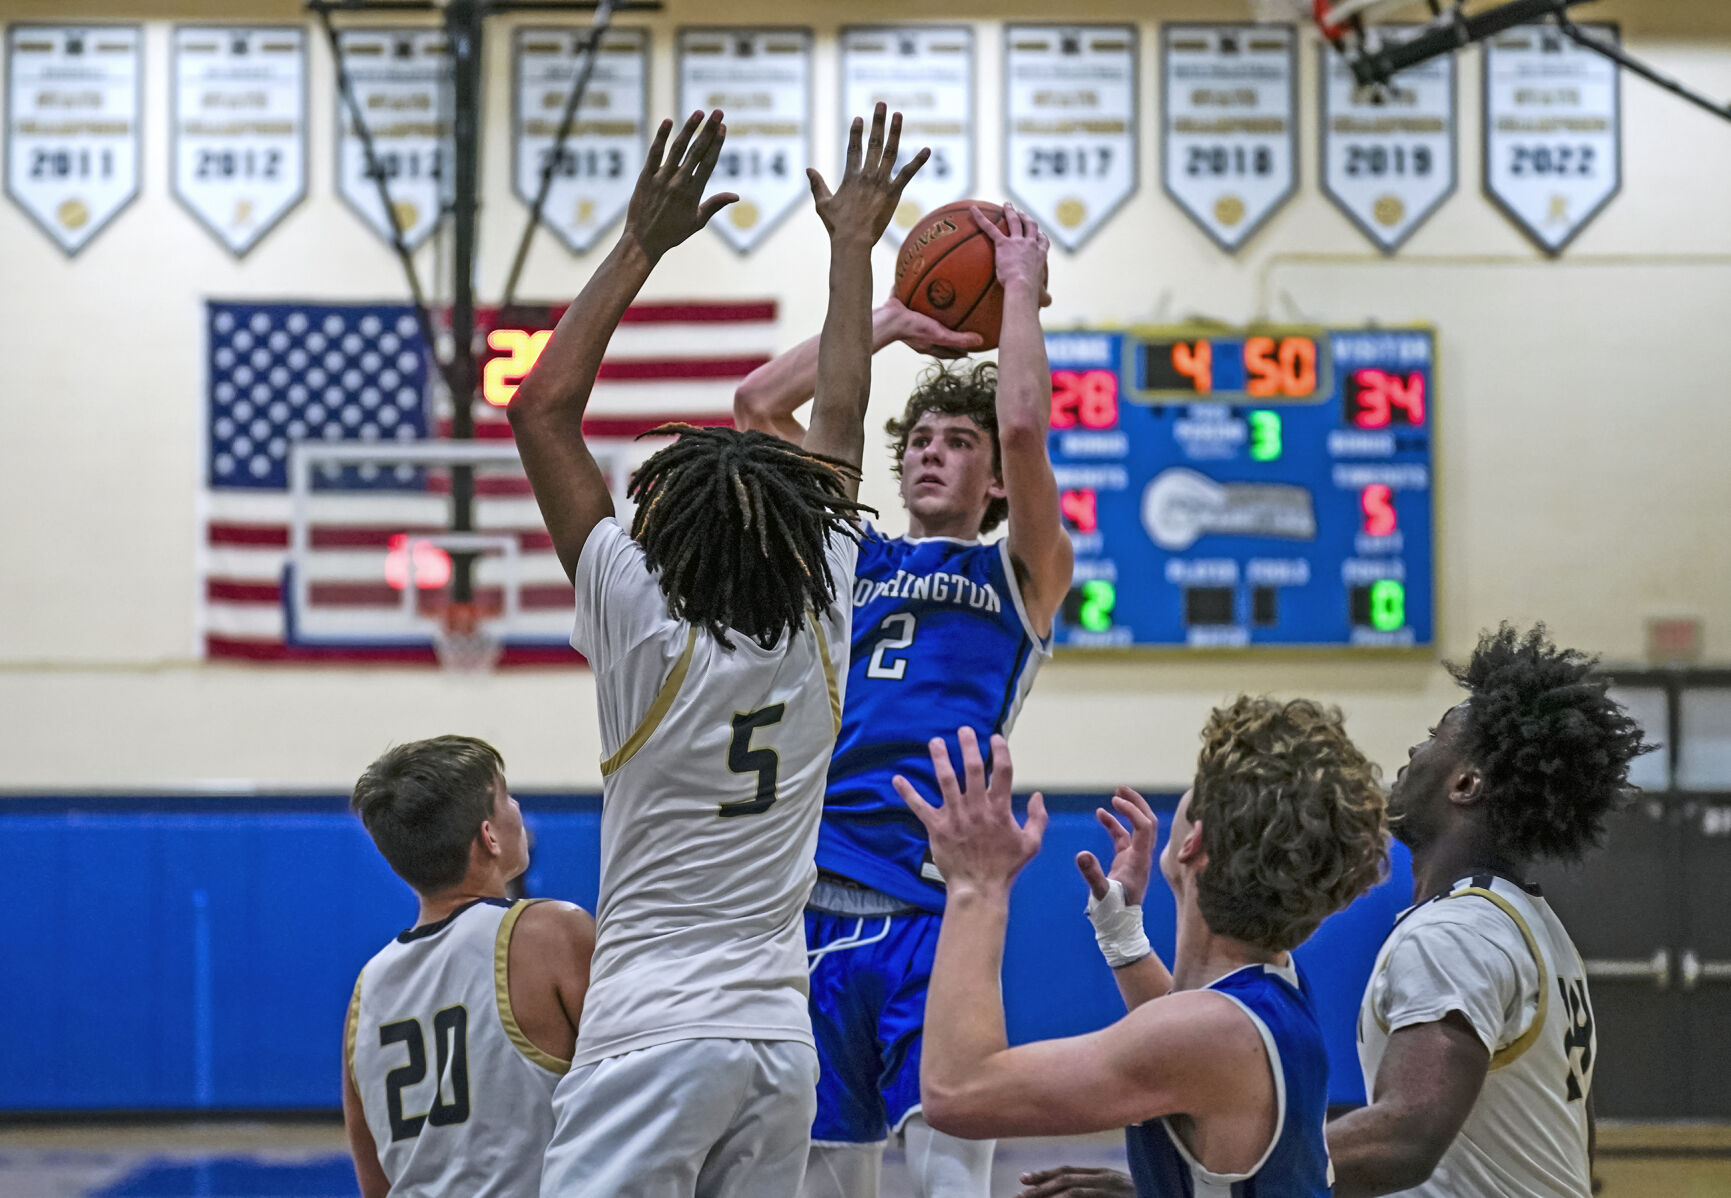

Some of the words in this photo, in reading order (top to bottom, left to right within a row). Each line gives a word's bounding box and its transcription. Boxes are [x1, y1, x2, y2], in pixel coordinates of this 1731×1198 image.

[29, 147, 114, 179] 2011
[193, 147, 284, 179] 2012
[1028, 146, 1113, 178] 2017
[1186, 145, 1272, 177] 2018
[1345, 145, 1432, 177] 2019
[1510, 145, 1596, 177] 2022
[484, 329, 553, 406] 2
[1244, 336, 1316, 397] 50
[1050, 370, 1118, 429] 28
[1354, 369, 1425, 429] 34
[1249, 410, 1282, 462] 3
[1061, 488, 1096, 533] 4
[1361, 484, 1396, 537] 5
[1080, 580, 1116, 632] 2
[1371, 580, 1405, 631] 0
[866, 611, 917, 680] 2
[718, 701, 786, 818] 5
[378, 1003, 471, 1143] 20
